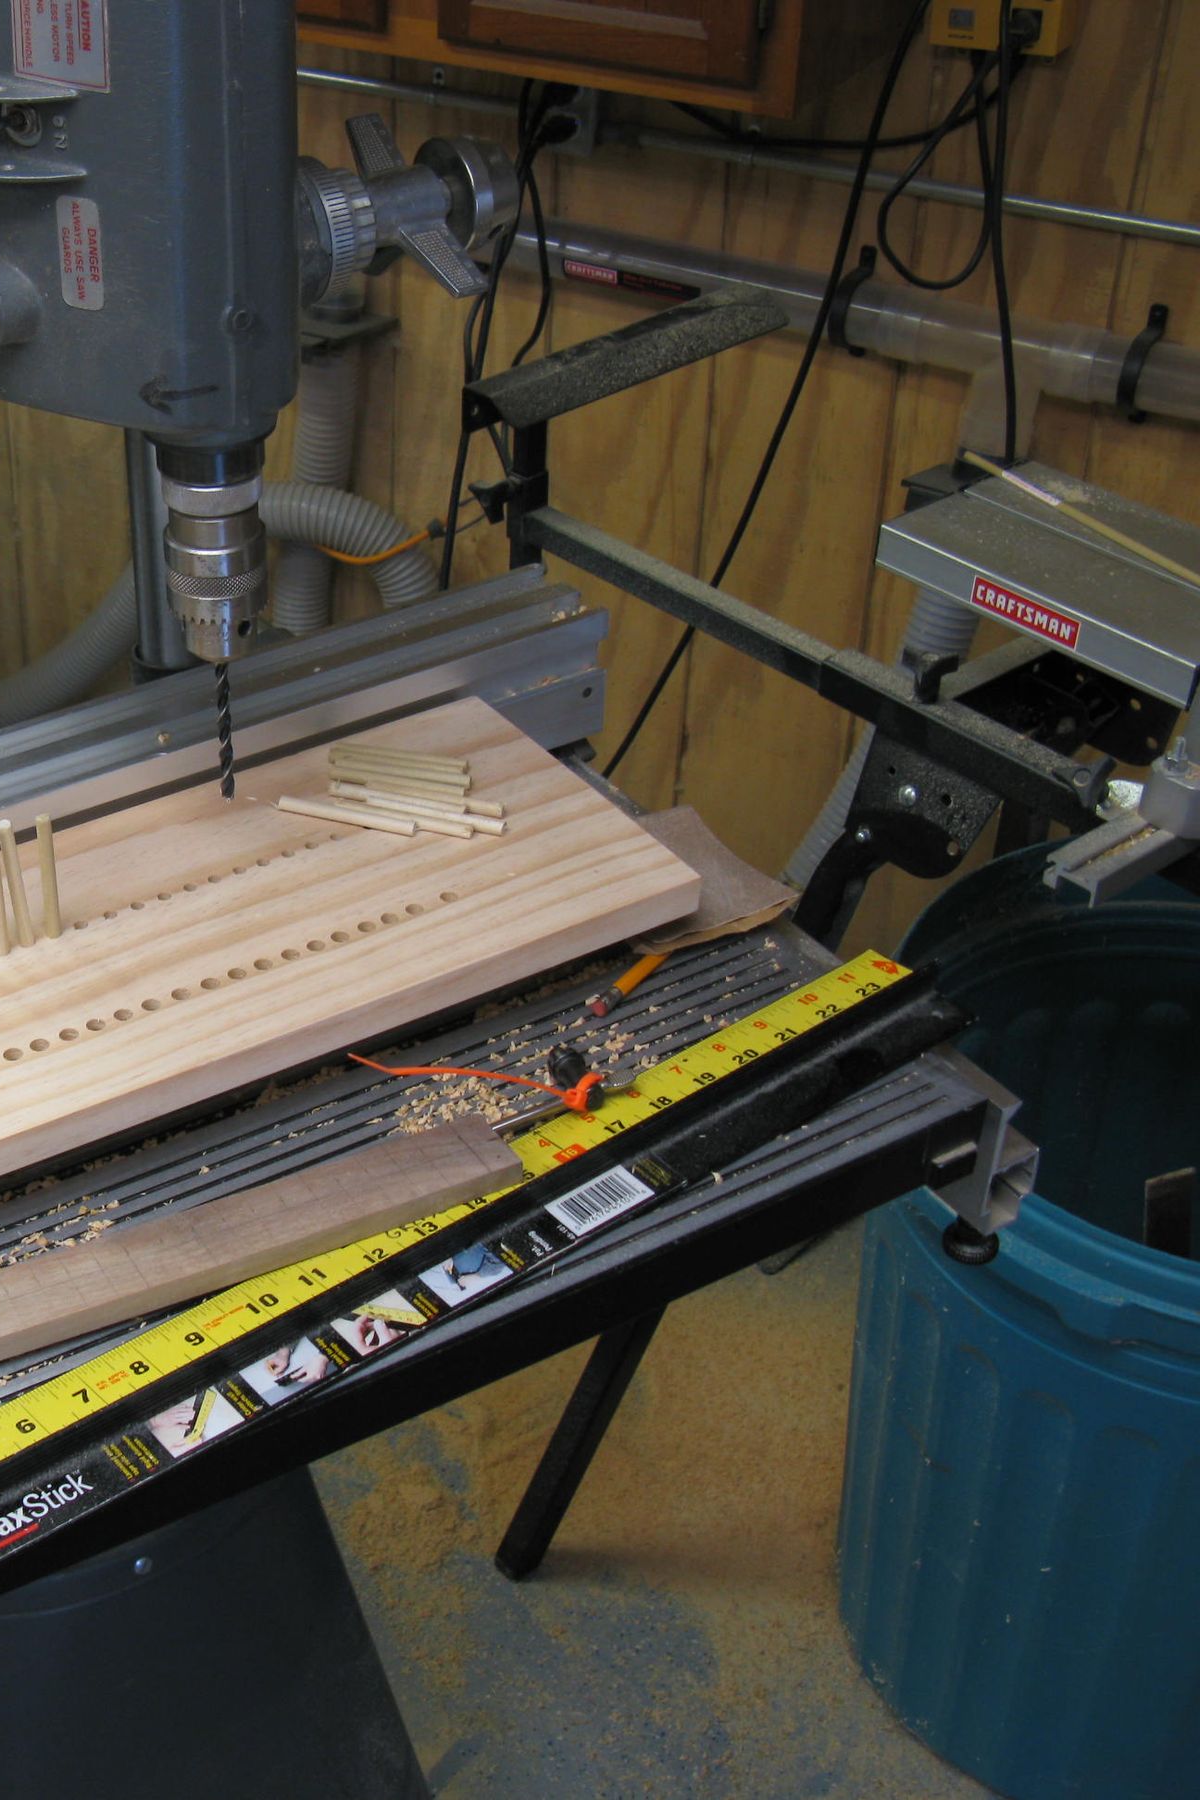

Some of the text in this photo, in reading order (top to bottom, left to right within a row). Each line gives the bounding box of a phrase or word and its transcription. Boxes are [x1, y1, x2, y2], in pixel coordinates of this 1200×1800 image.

[22, 0, 31, 28] ORCE
[65, 3, 75, 65] TURN SPEED
[81, 0, 92, 52] AUTION
[51, 24, 61, 62] MOTOR
[62, 227, 72, 273] GUARDS
[71, 201, 86, 300] ALWAYS USE SAW
[87, 227, 100, 283] DANGER
[975, 583, 1072, 642] CRAFTSMAN
[538, 1138, 551, 1148] 4
[669, 1065, 683, 1075] 7
[712, 1043, 726, 1053] 8
[752, 1021, 768, 1030] 9
[798, 993, 819, 1006] 10
[837, 972, 856, 984] 11
[15, 1418, 36, 1434] 6
[72, 1388, 91, 1403] 7
[129, 1360, 150, 1375] 8
[184, 1331, 205, 1346] 9
[245, 1293, 280, 1314] 10
[298, 1267, 328, 1287] 11
[363, 1247, 390, 1264] 12
[413, 1221, 439, 1237] 13
[463, 1196, 488, 1210] 14
[604, 1119, 626, 1135] 17
[649, 1095, 673, 1110] 18
[693, 1072, 717, 1086] 19
[732, 1048, 759, 1066] 20
[774, 1027, 798, 1042] 21
[815, 1003, 841, 1019] 22
[855, 982, 881, 997] 23
